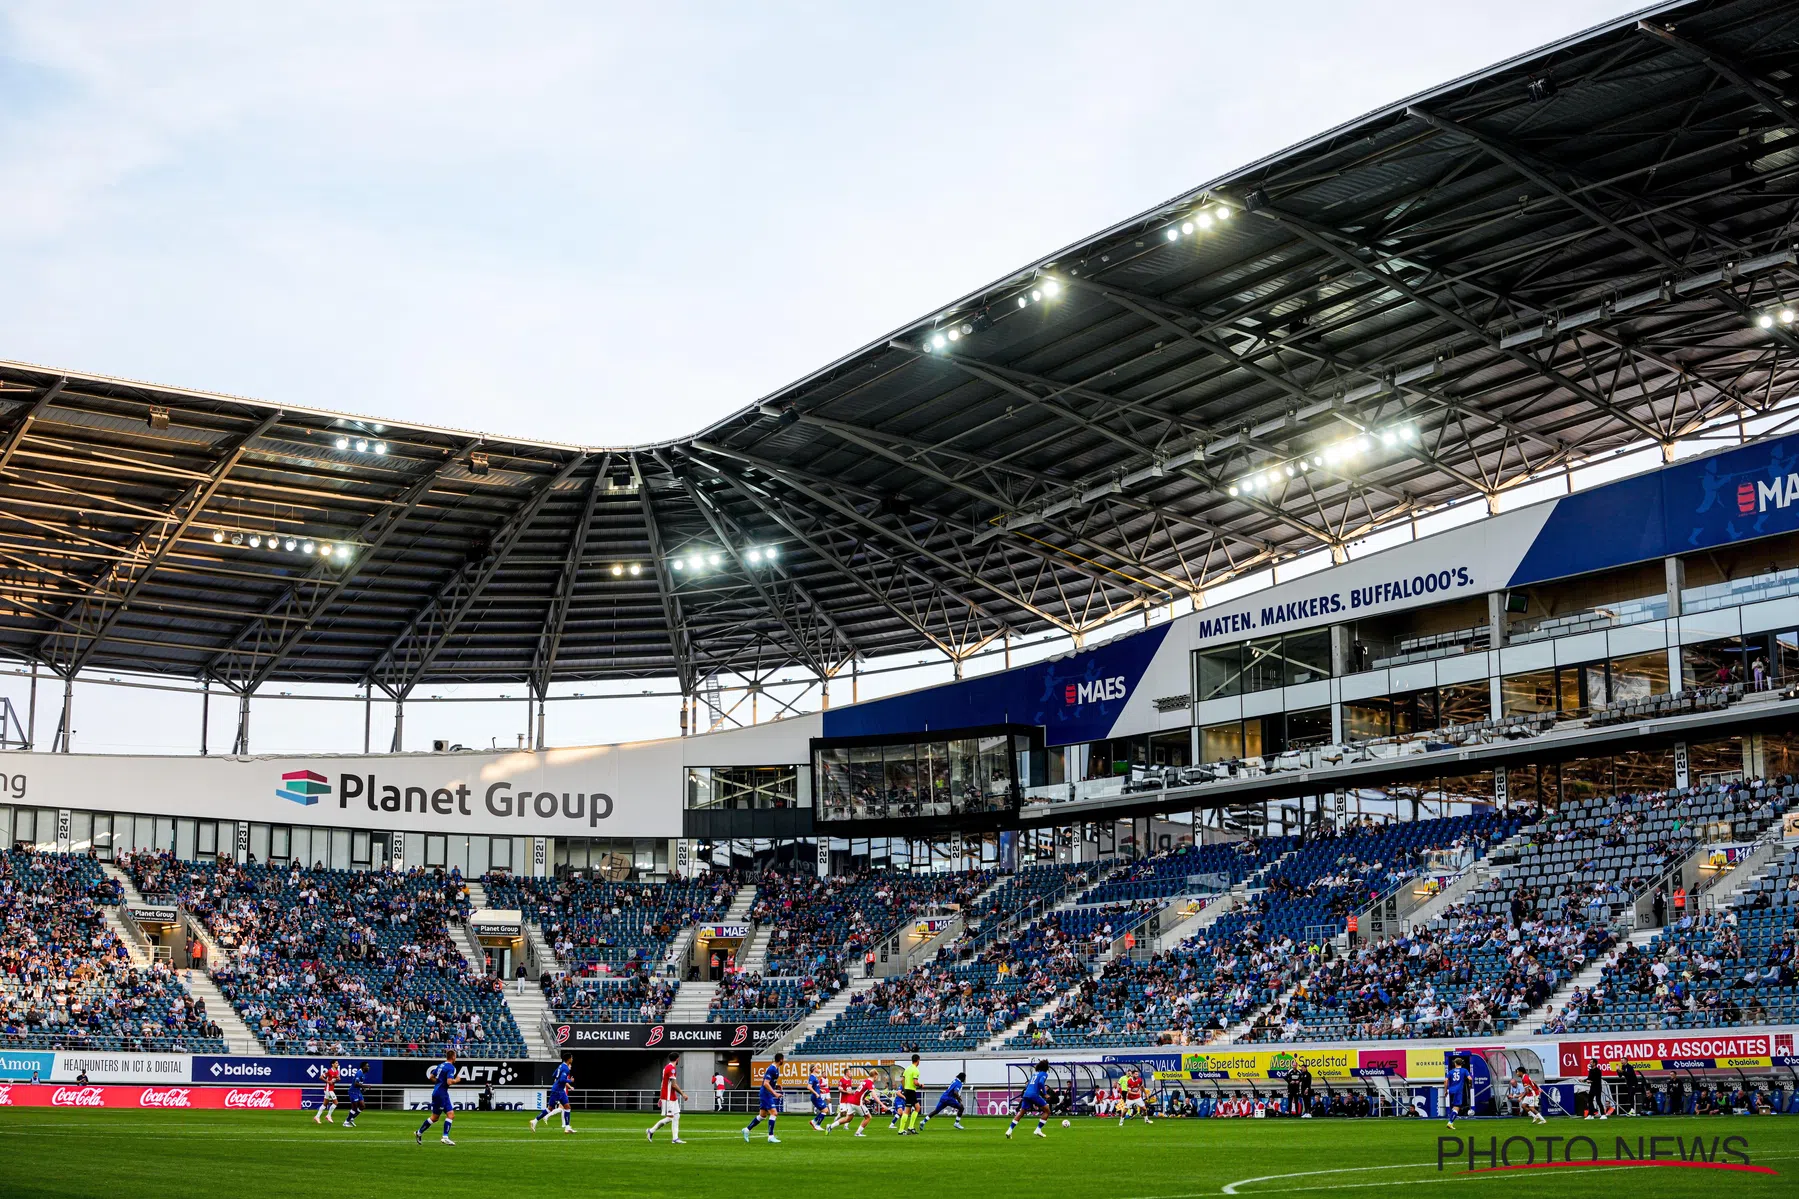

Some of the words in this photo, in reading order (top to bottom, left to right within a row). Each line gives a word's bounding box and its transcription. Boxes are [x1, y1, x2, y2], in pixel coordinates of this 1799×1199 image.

[1757, 473, 1799, 512] MA
[1199, 612, 1256, 639] MATEN.
[1261, 593, 1346, 627] MAKKERS.
[1351, 566, 1474, 609] BUFFALOOO'S.
[1077, 675, 1126, 705] MAES
[1677, 752, 1686, 778] 125
[1496, 776, 1506, 800] 126
[340, 773, 471, 815] Planet
[485, 782, 614, 828] Group
[1336, 796, 1344, 820] 126
[59, 818, 69, 839] 224
[238, 830, 247, 851] 223
[394, 839, 403, 860] 223
[535, 844, 544, 865] 222
[678, 846, 687, 866] 222
[819, 845, 828, 864] 221
[952, 839, 960, 859] 221
[156, 910, 175, 919] Group
[1639, 913, 1650, 924] 15
[500, 925, 519, 933] Group
[576, 1031, 630, 1041] BACKLINE
[669, 1031, 722, 1041] BACKLINE
[753, 1030, 788, 1041] BACKLI
[1583, 1044, 1600, 1059] LE
[1603, 1043, 1654, 1059] GRAND
[1657, 1041, 1668, 1057] &
[1671, 1039, 1767, 1057] ASSOCIATES
[0, 1057, 41, 1071] Amon
[64, 1058, 119, 1072] HEADHUNTERS
[121, 1059, 130, 1072] IN
[132, 1060, 145, 1073] ICT
[147, 1061, 153, 1073] &
[155, 1061, 183, 1074] DIGITAL
[1156, 1060, 1177, 1072] VALK
[1184, 1058, 1208, 1071] Mega
[1210, 1056, 1256, 1071] Speelstad
[1299, 1054, 1347, 1068] Speelstad
[1366, 1060, 1399, 1069] CWS
[1587, 1062, 1612, 1072] SOOR
[1632, 1061, 1652, 1069] aloise
[1680, 1060, 1705, 1068] baloise
[1735, 1058, 1760, 1066] baloise
[224, 1063, 272, 1076] baloise
[320, 1064, 359, 1078] blois
[426, 1065, 499, 1082] CAFT
[1453, 1071, 1460, 1082] 35
[52, 1087, 101, 1106] Coca-Cola
[140, 1088, 187, 1107] Coca-Cola
[224, 1089, 271, 1108] Coca-Cola
